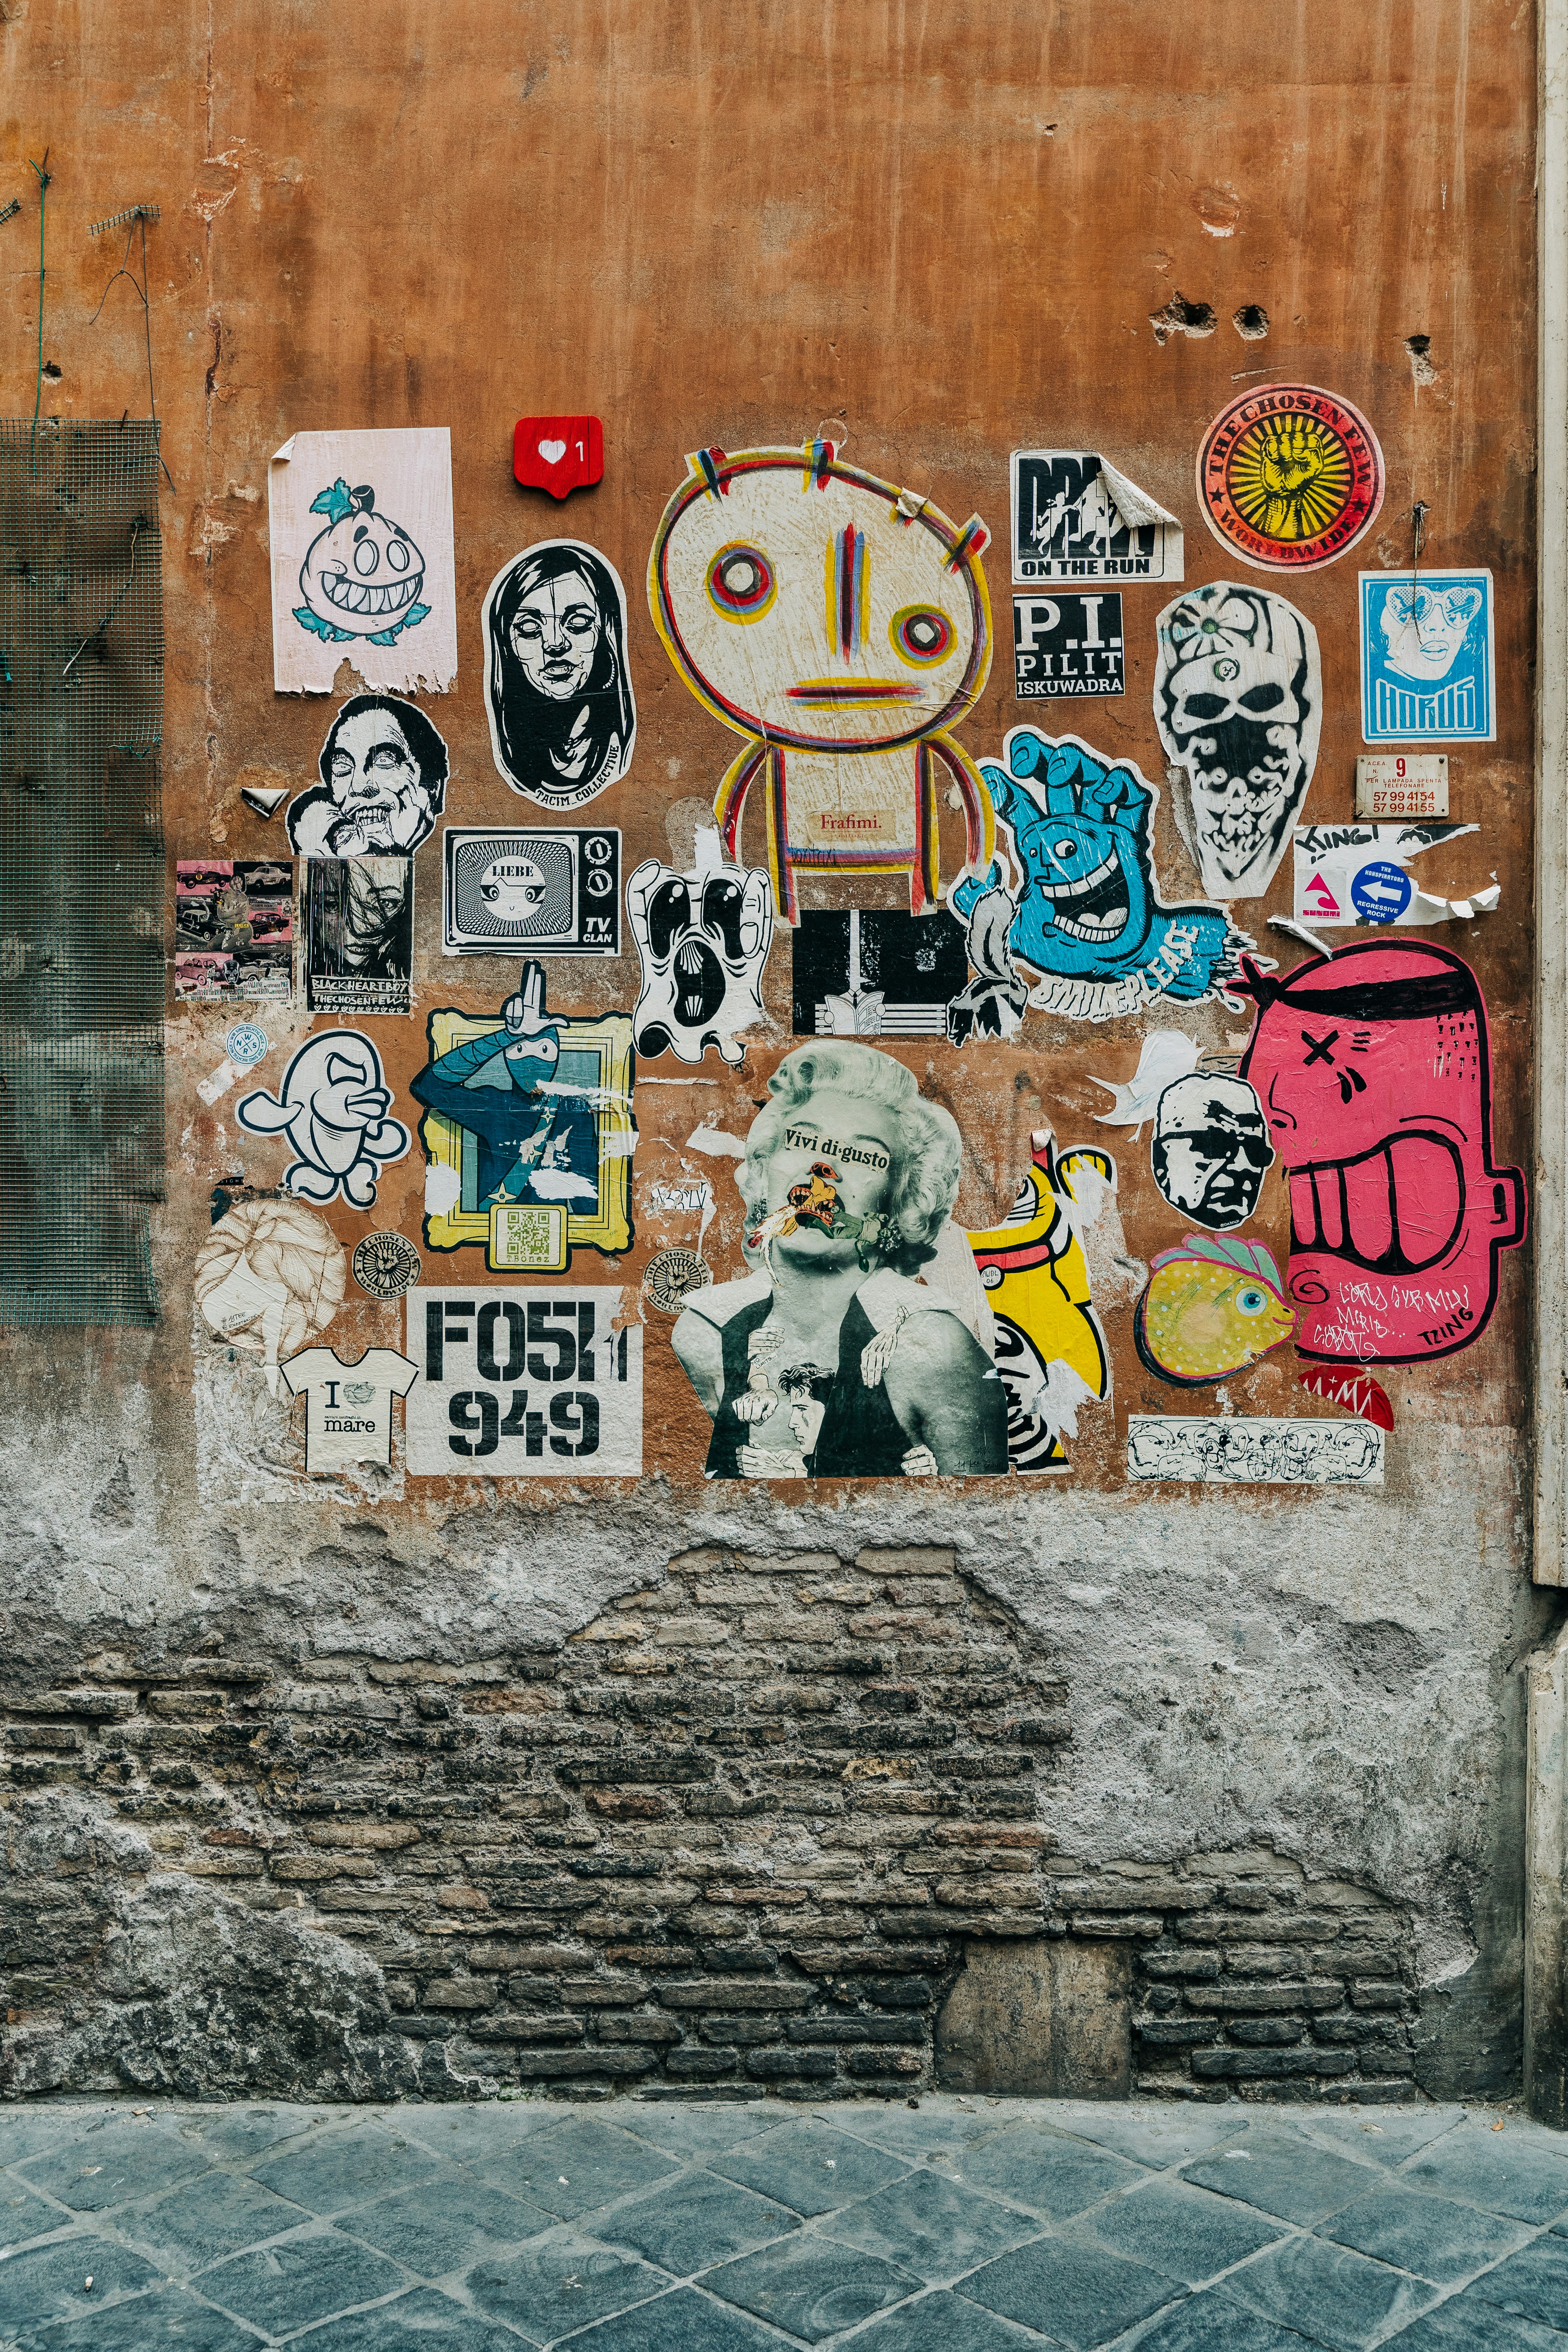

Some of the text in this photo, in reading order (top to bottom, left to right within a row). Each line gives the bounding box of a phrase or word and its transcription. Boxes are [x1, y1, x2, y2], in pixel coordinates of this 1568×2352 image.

[1209, 395, 1371, 487] THE CHOSEN FEW
[576, 441, 584, 462] 1
[1220, 509, 1356, 558] WORLDWIDE
[1021, 559, 1149, 576] ON THE RUN
[1014, 596, 1121, 651] P.I.
[1017, 652, 1121, 677] PILIT
[1018, 678, 1123, 694] ISKUWADRA
[1376, 675, 1476, 732] HORUS
[1396, 758, 1406, 777] 9
[1373, 792, 1387, 801] 57
[1390, 791, 1405, 801] 99
[1373, 803, 1387, 812] 57
[1389, 803, 1405, 812] 99
[821, 814, 882, 829] Frafimi.
[492, 866, 534, 876] LIEBE
[1357, 900, 1398, 914] REGRESSIVE
[586, 918, 611, 932] TV
[583, 934, 612, 942] CLAN
[246, 1026, 260, 1035] RICHTIG
[233, 1053, 248, 1062] RICHTIG
[786, 1129, 818, 1151] Vivi
[356, 1235, 418, 1270] THE CHOSEN FEW
[698, 1263, 708, 1284] FEW
[361, 1276, 411, 1296] WORLDWIDE
[1417, 1307, 1473, 1345] TZING
[756, 1356, 776, 1369] LIMITS...
[325, 1381, 340, 1408] I
[324, 1420, 375, 1433] mare
[449, 1390, 600, 1456] 949
